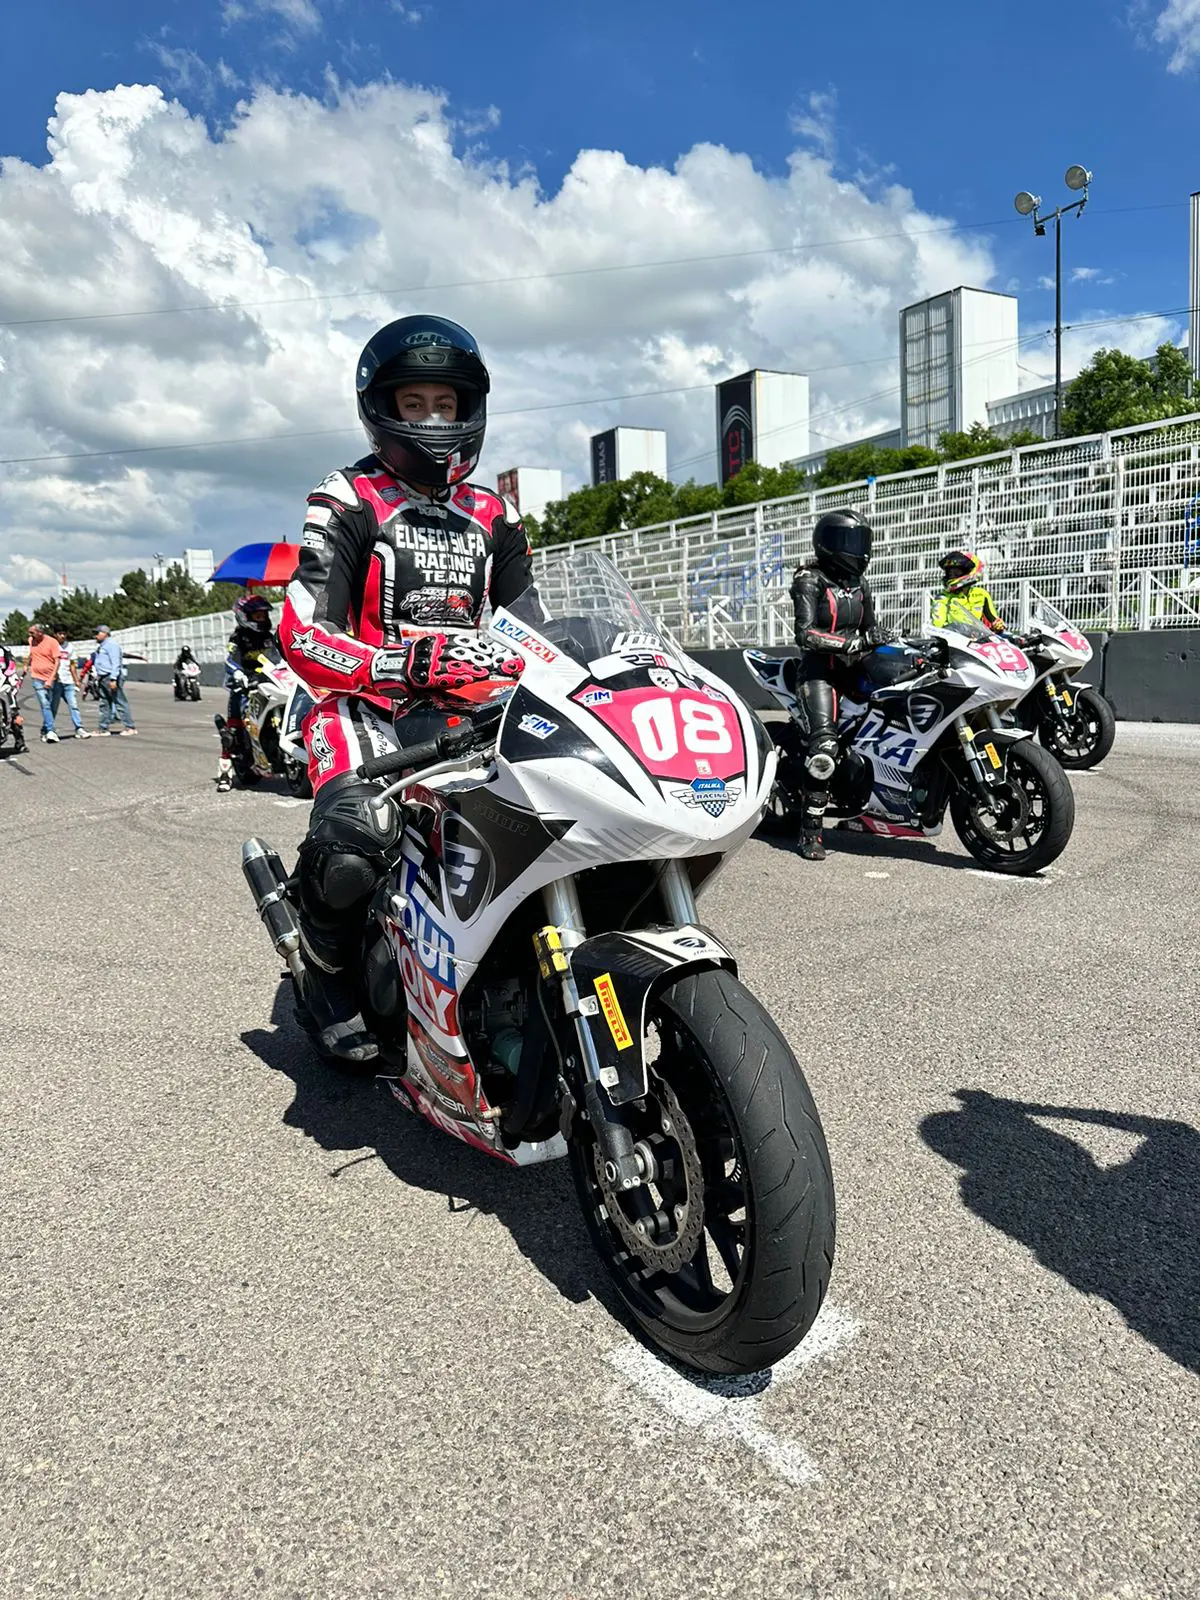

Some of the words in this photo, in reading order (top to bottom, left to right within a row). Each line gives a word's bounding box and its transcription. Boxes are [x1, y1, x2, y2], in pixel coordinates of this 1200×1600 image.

[414, 551, 475, 573] RACING
[421, 569, 471, 586] TEAM
[520, 636, 558, 662] MOLY
[585, 691, 610, 702] FIM
[525, 716, 556, 735] FIM
[632, 697, 732, 762] 08
[697, 792, 728, 800] RACING
[598, 980, 628, 1043] PIRELLI
